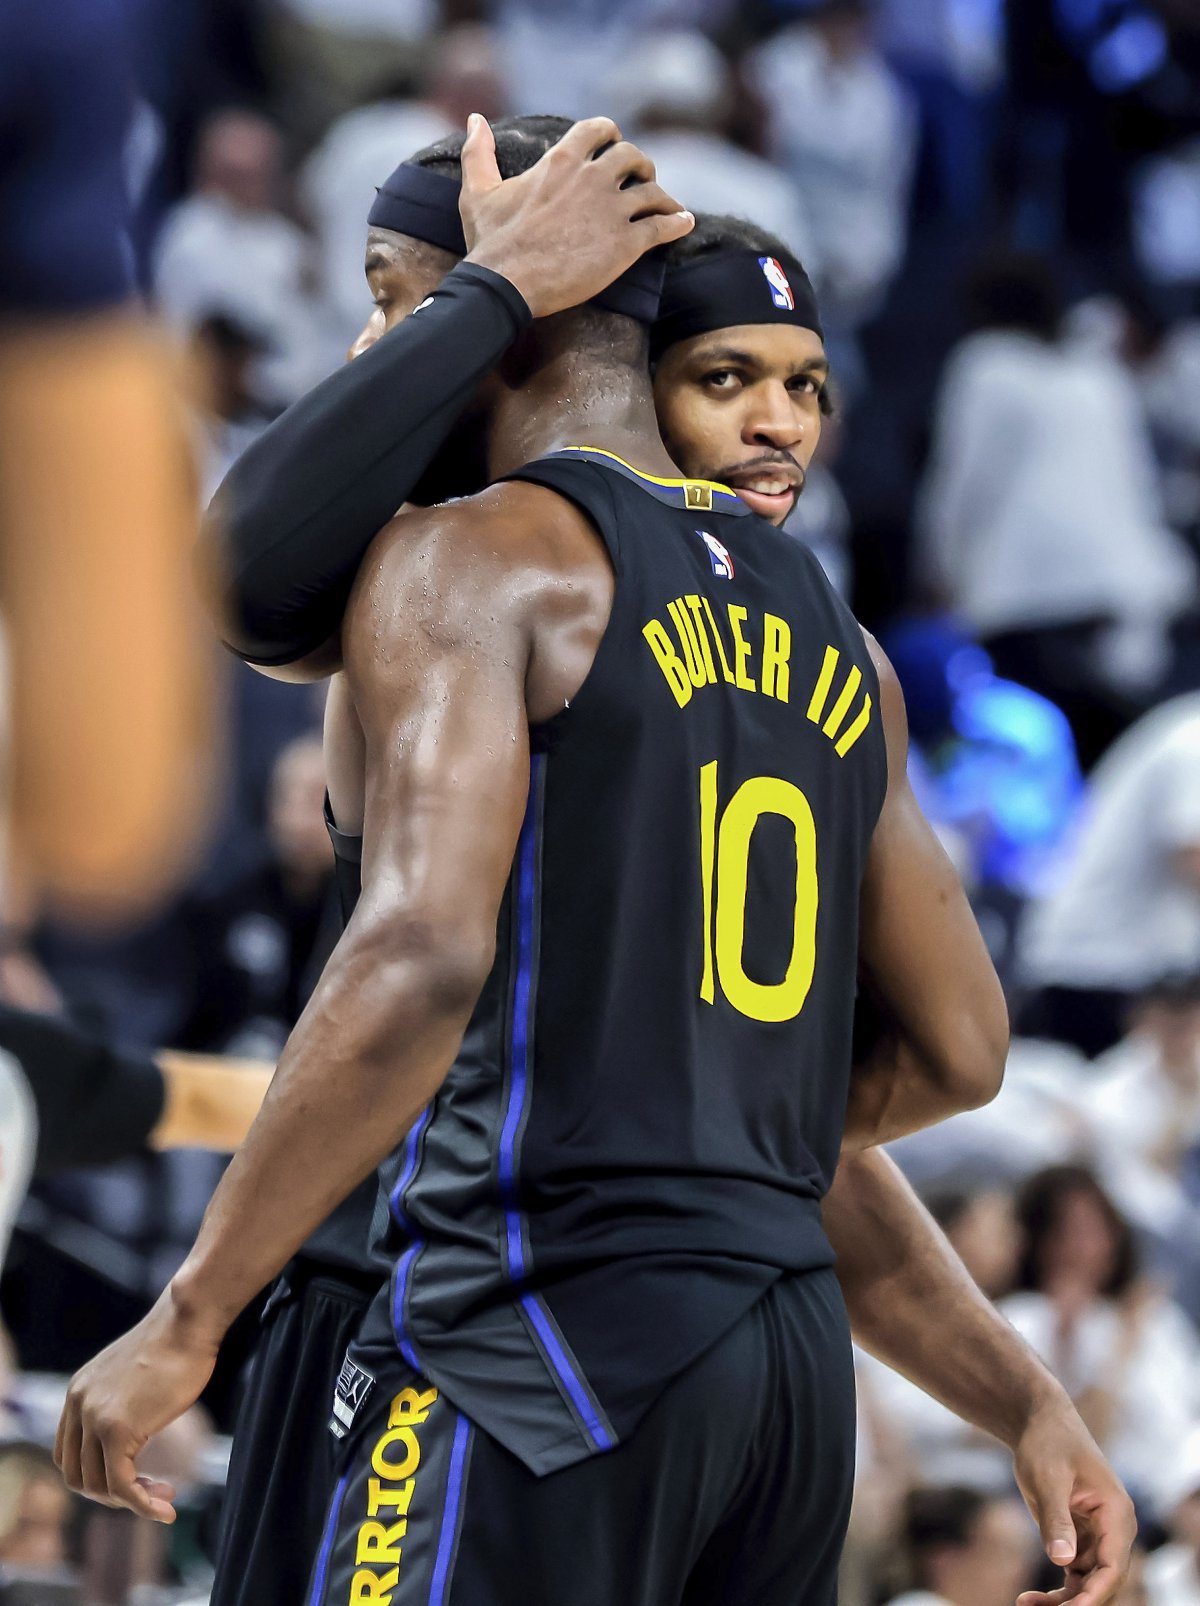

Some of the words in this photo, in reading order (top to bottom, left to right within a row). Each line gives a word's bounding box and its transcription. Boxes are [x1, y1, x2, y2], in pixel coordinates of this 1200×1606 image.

[641, 594, 792, 709] BUTLER
[806, 644, 872, 758] III
[699, 759, 819, 1023] 10
